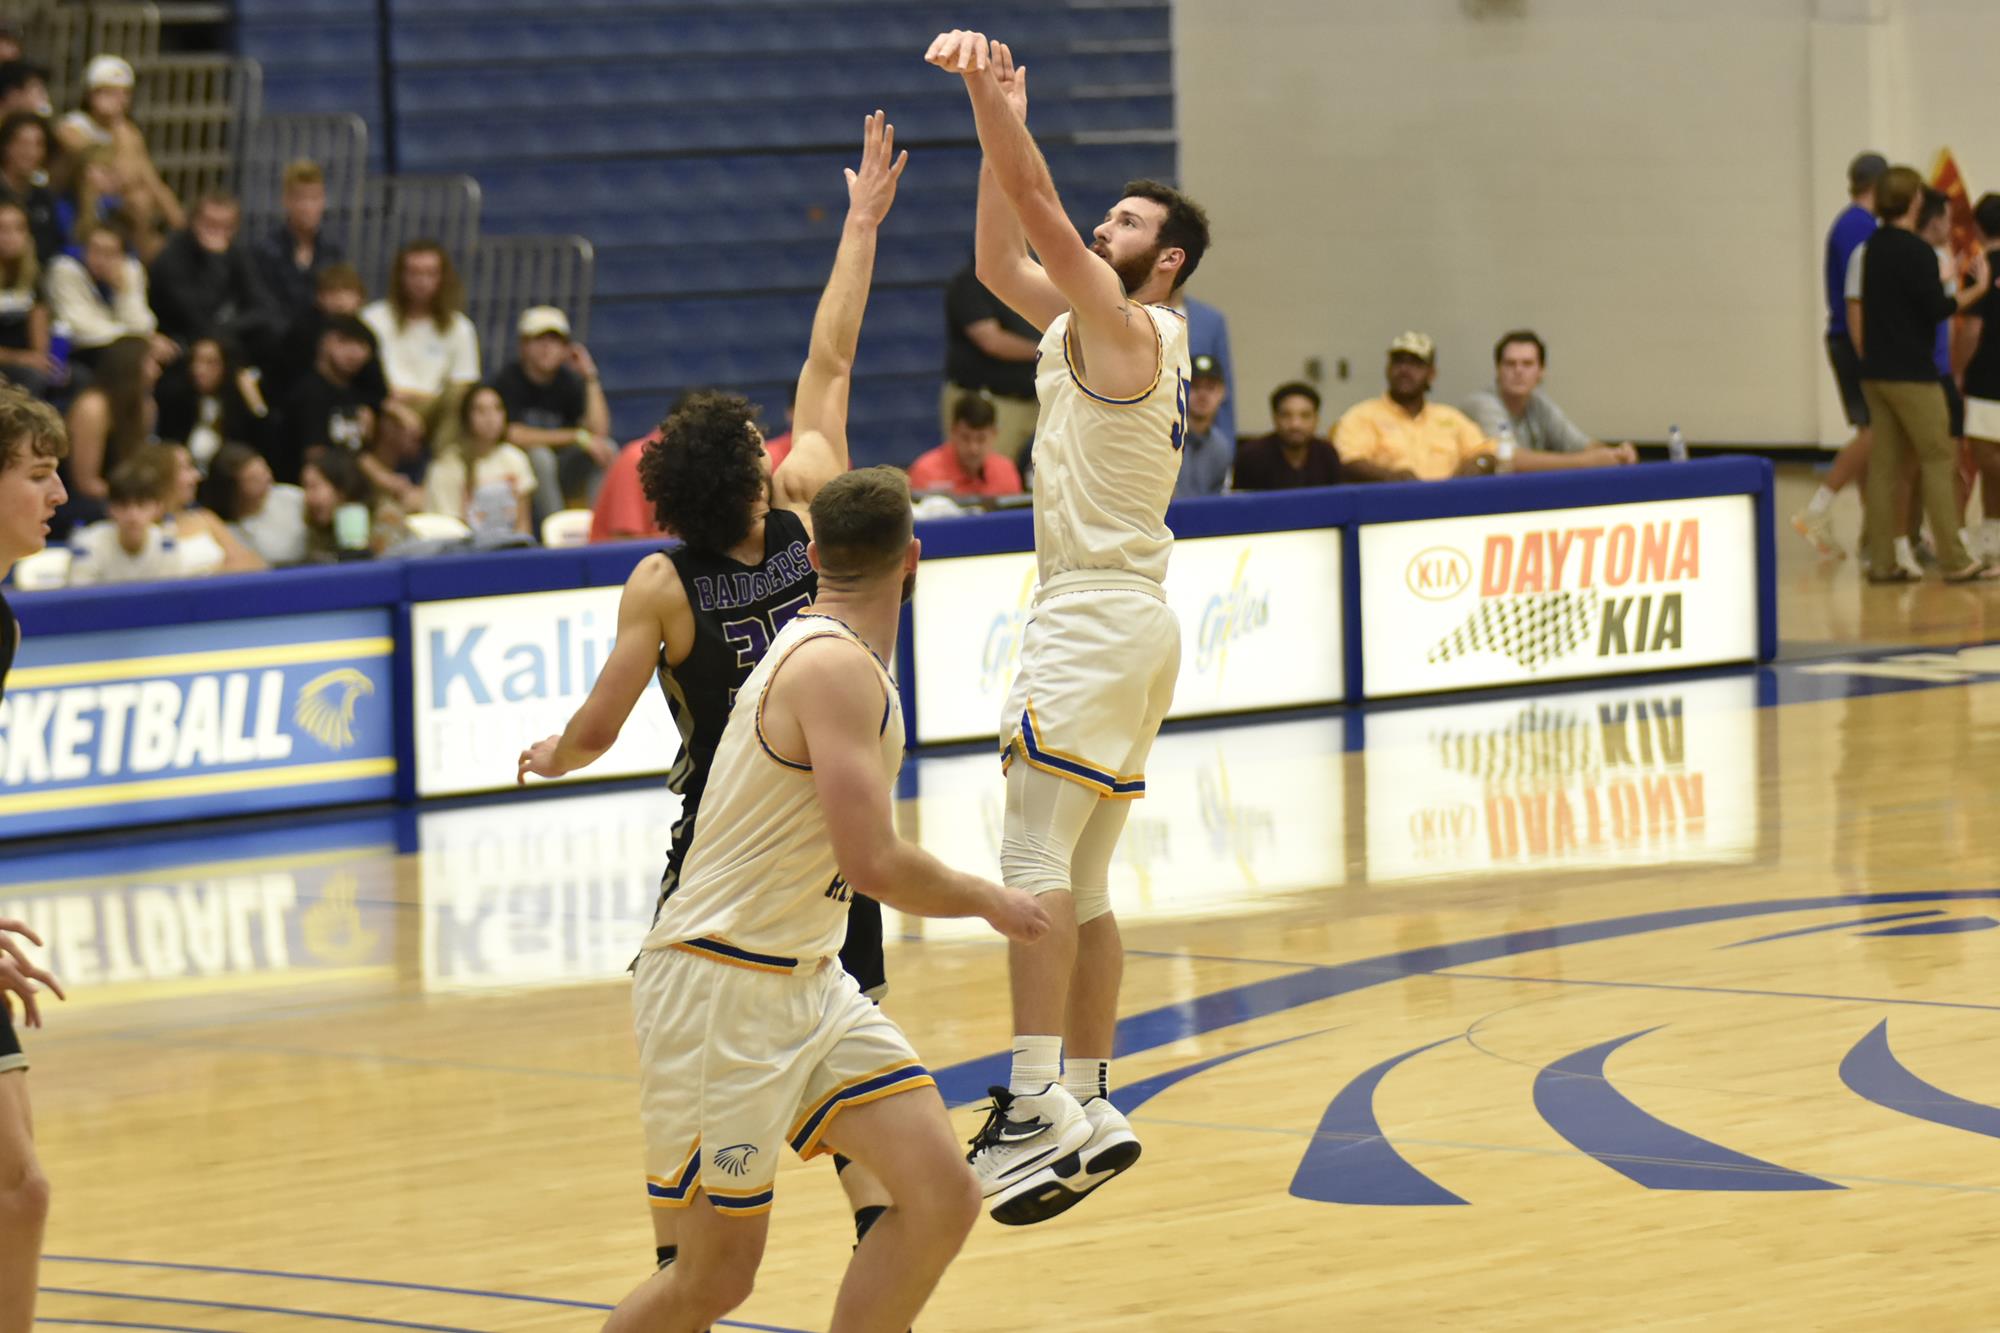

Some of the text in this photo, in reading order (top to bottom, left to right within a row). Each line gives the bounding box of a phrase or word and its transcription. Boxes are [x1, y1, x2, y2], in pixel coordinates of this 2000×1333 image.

[694, 541, 813, 611] BADGERS
[1417, 560, 1462, 589] KIA
[1479, 519, 1700, 598] DAYTONA
[1597, 592, 1683, 657] KIA
[429, 610, 617, 710] Kali
